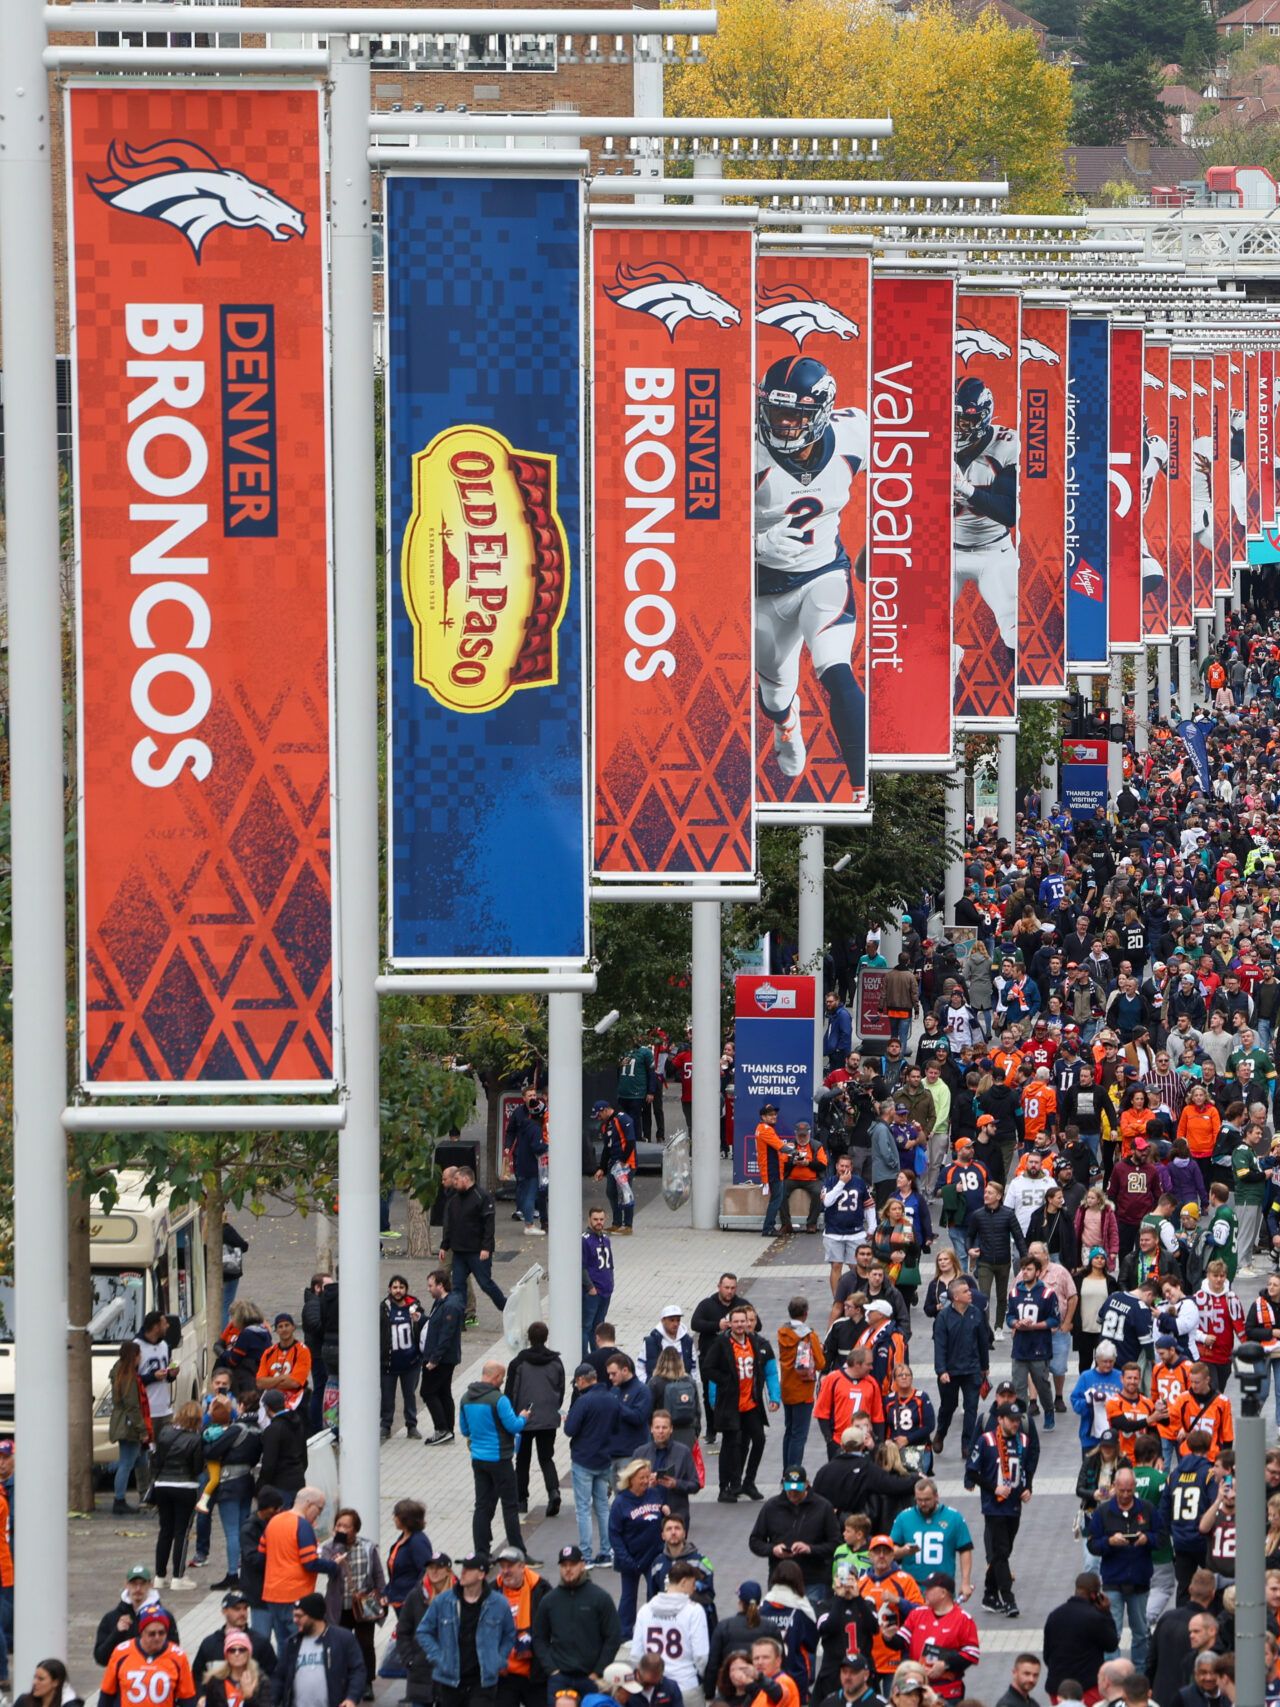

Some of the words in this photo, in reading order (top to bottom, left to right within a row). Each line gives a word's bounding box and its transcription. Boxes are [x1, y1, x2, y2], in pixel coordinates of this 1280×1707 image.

[226, 313, 271, 528] DENVER
[1029, 392, 1045, 475] DENVER
[1259, 377, 1269, 465] MARRIOTT
[687, 373, 714, 512] DENVER
[870, 360, 930, 568] valspar
[448, 450, 498, 529] OLD
[624, 367, 676, 682] BRONCOS
[784, 496, 824, 545] 2
[125, 303, 213, 788] BRONCOS
[428, 527, 436, 586] ESTABLISHED
[464, 531, 509, 583] EL
[1074, 567, 1101, 597] Virgin
[869, 577, 908, 670] paint
[1051, 884, 1065, 898] 13
[1127, 934, 1143, 949] 20
[781, 996, 790, 1005] IG
[741, 1064, 784, 1074] THANKS
[786, 1064, 807, 1074] FOR
[1035, 1050, 1048, 1063] 52
[747, 1086, 800, 1096] WEMBLEY
[752, 1075, 796, 1085] VISITING
[1061, 1072, 1073, 1089] 11
[1024, 1098, 1039, 1118] 18
[959, 1171, 979, 1192] 18
[1127, 1172, 1147, 1193] 21
[837, 1189, 858, 1211] 23
[1021, 1189, 1044, 1207] 53
[597, 1247, 610, 1270] 52
[1109, 1298, 1131, 1313] ELLIOTT
[391, 1322, 412, 1351] 10
[1101, 1310, 1126, 1341] 21
[849, 1391, 862, 1414] 7
[1157, 1378, 1181, 1403] 58
[893, 1407, 913, 1430] 18
[1178, 1472, 1197, 1483] ALLEN
[1172, 1486, 1200, 1520] 13
[913, 1531, 944, 1565] 16
[1212, 1530, 1236, 1558] 12
[646, 1626, 683, 1659] 58
[845, 1622, 858, 1655] 1
[126, 1670, 171, 1703] 30
